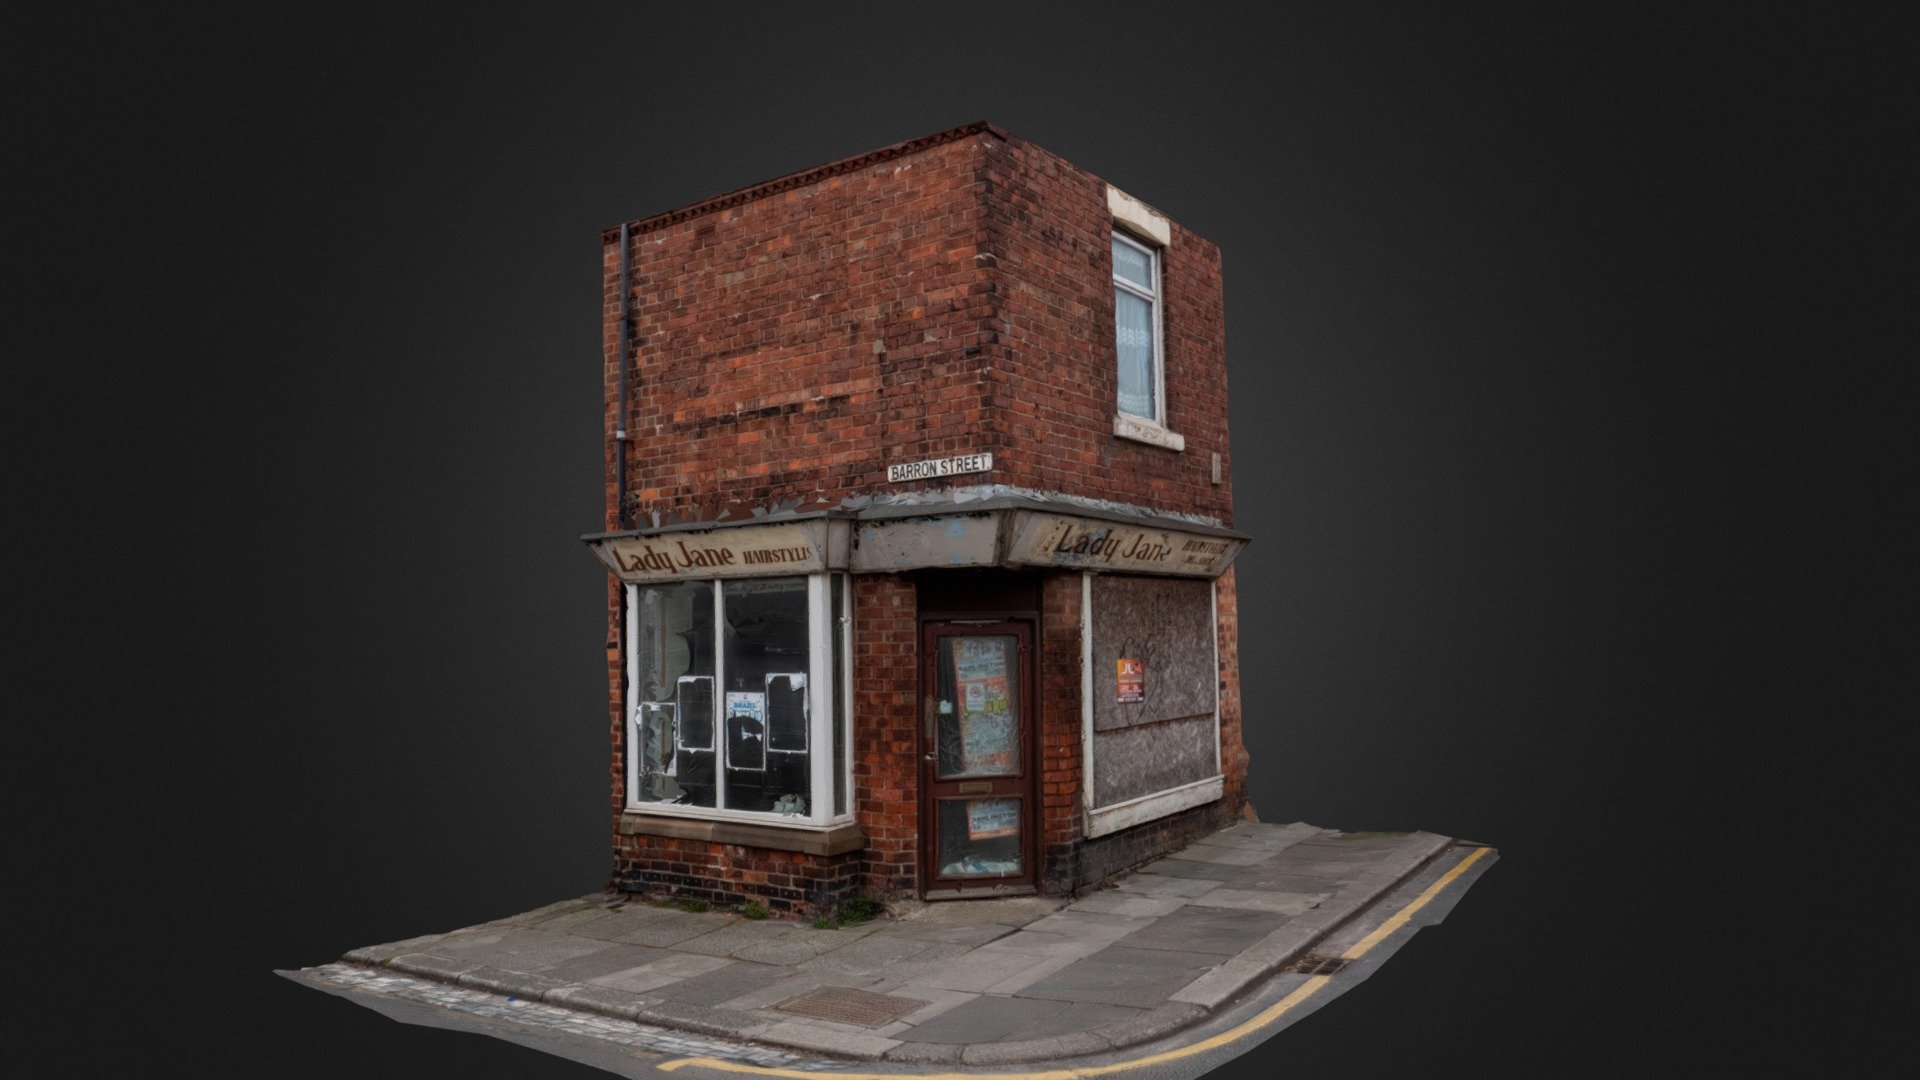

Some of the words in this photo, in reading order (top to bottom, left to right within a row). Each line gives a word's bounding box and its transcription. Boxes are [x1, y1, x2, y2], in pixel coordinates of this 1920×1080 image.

[892, 461, 938, 480] BARRON
[940, 454, 988, 475] STREET
[613, 545, 677, 574] Lady
[676, 541, 736, 569] Jane
[1053, 525, 1121, 562] Lady
